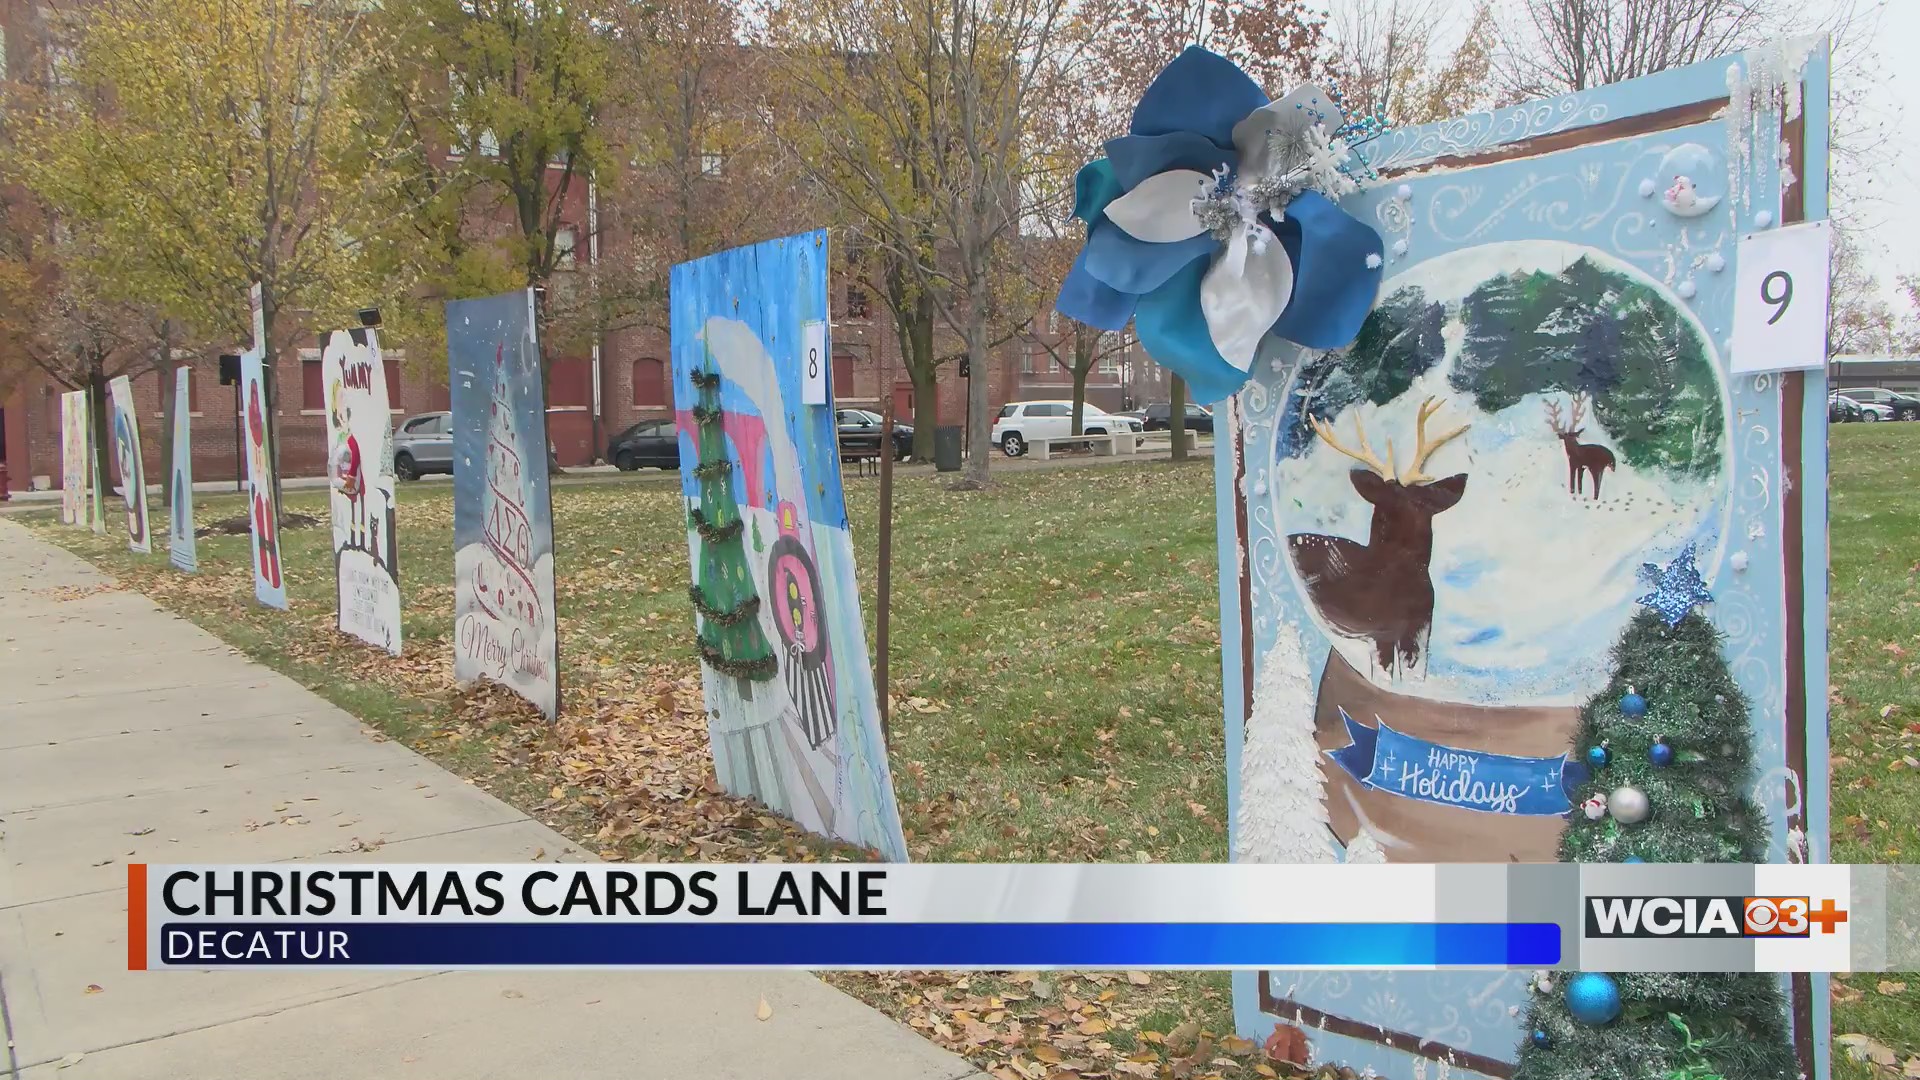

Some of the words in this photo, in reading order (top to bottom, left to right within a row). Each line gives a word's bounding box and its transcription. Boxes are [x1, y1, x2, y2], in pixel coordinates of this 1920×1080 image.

[1759, 270, 1794, 325] 9
[809, 348, 818, 378] 8
[461, 614, 507, 679] Merry
[1398, 760, 1530, 813] Holidays
[1428, 747, 1479, 773] HAPPY
